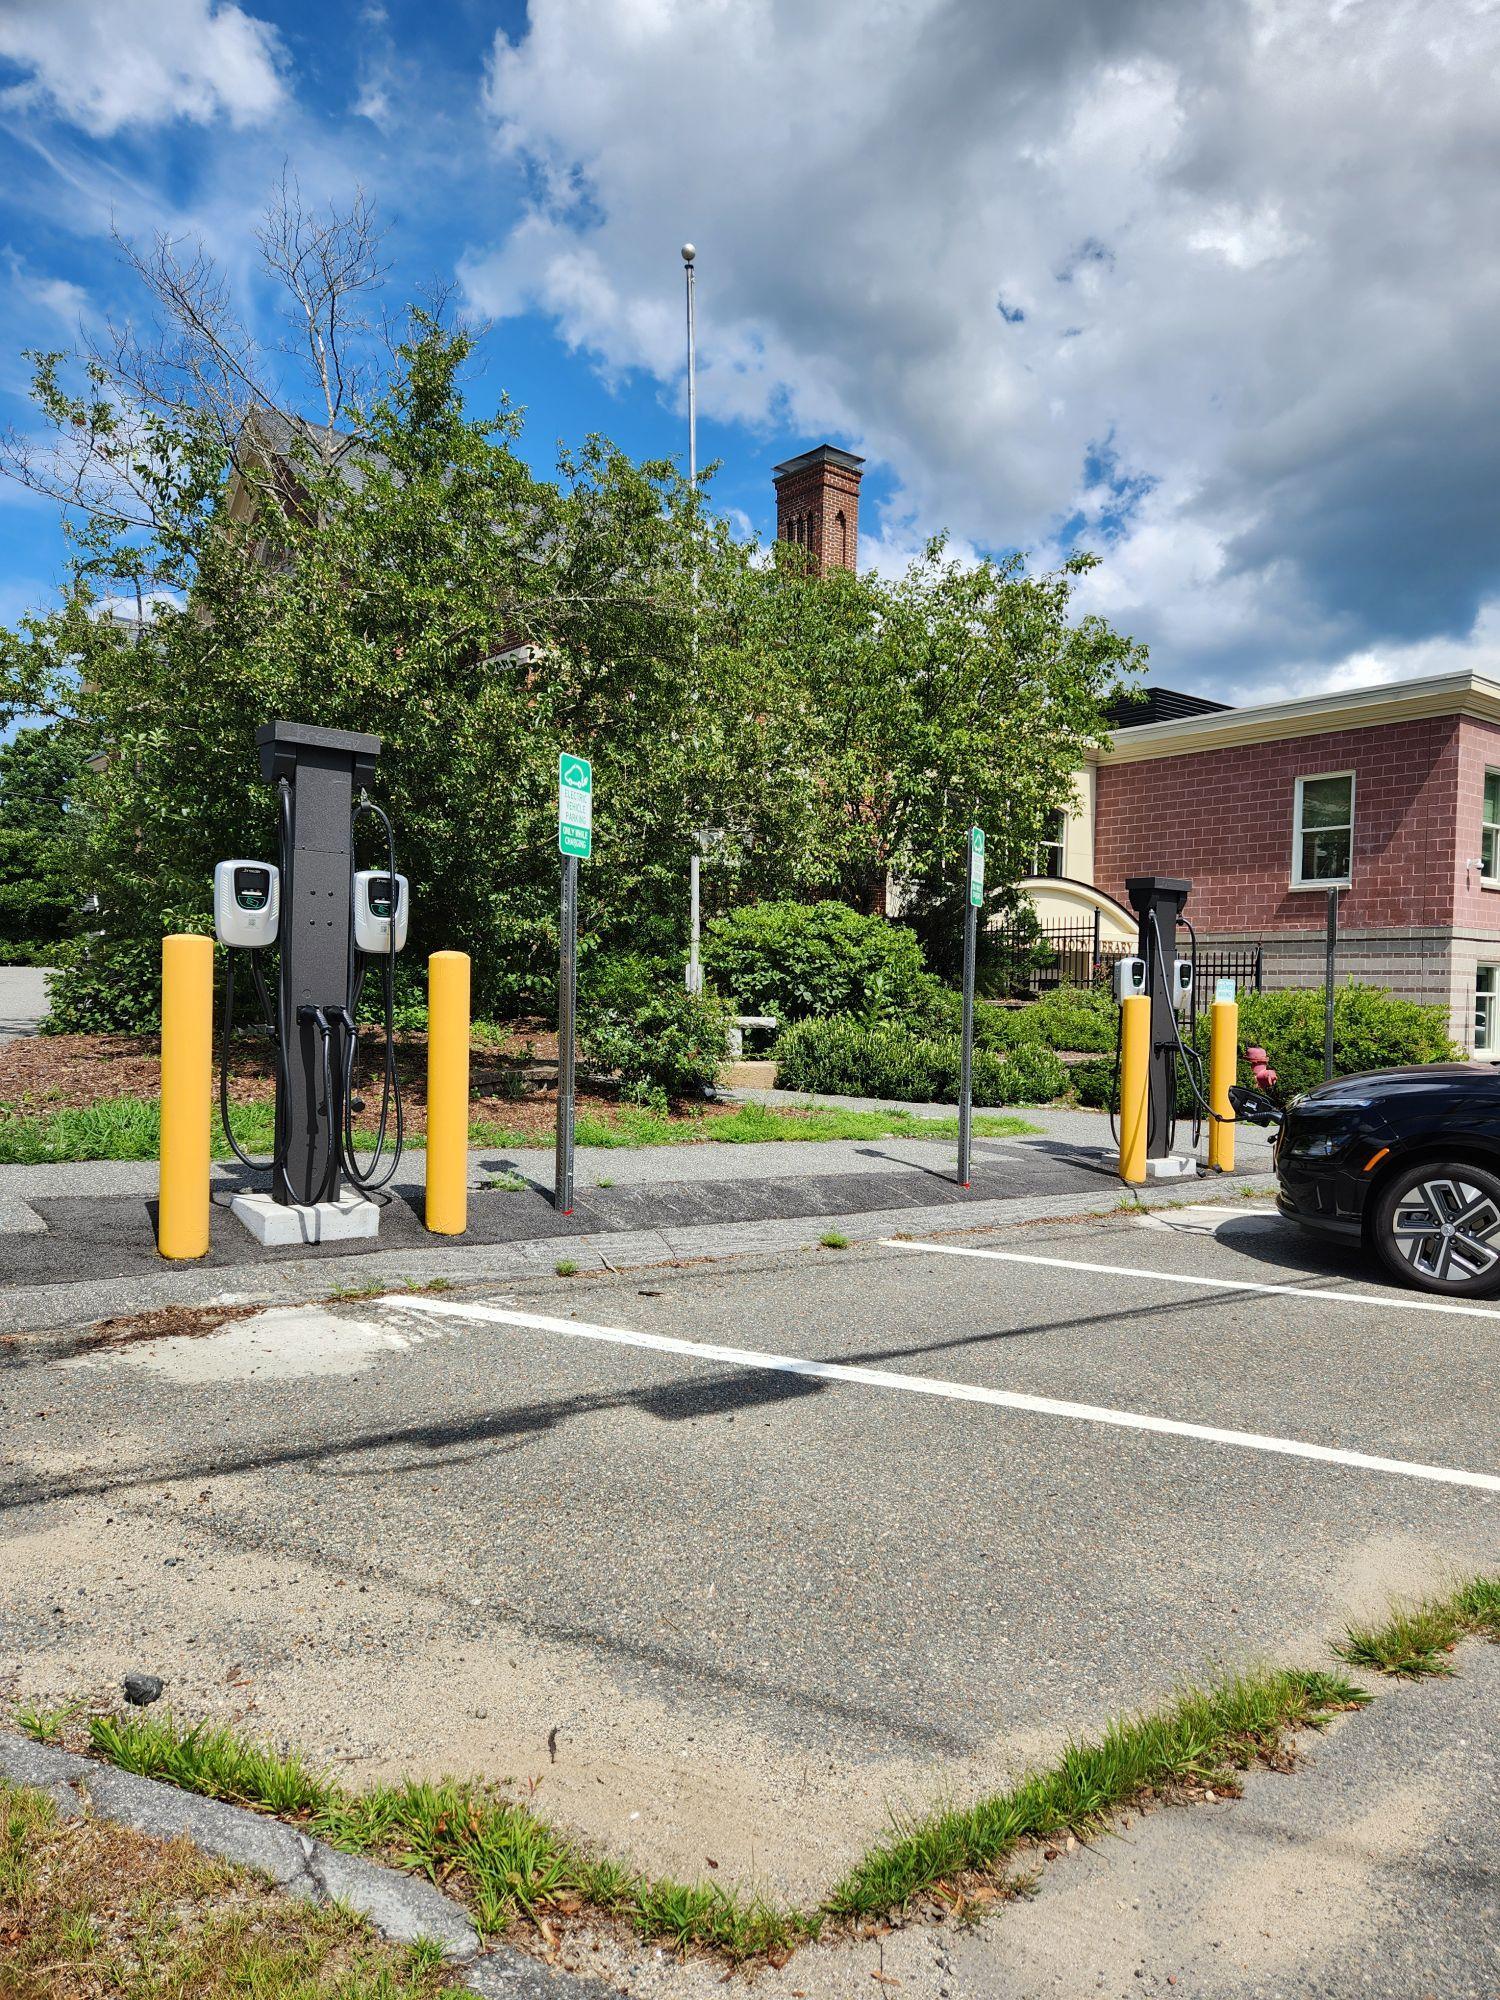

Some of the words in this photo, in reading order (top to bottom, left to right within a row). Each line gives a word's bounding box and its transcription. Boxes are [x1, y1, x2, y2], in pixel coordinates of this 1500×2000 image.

[564, 788, 587, 803] ELECTRIC
[566, 800, 587, 815] VEHICLE
[565, 811, 587, 825] PARKING
